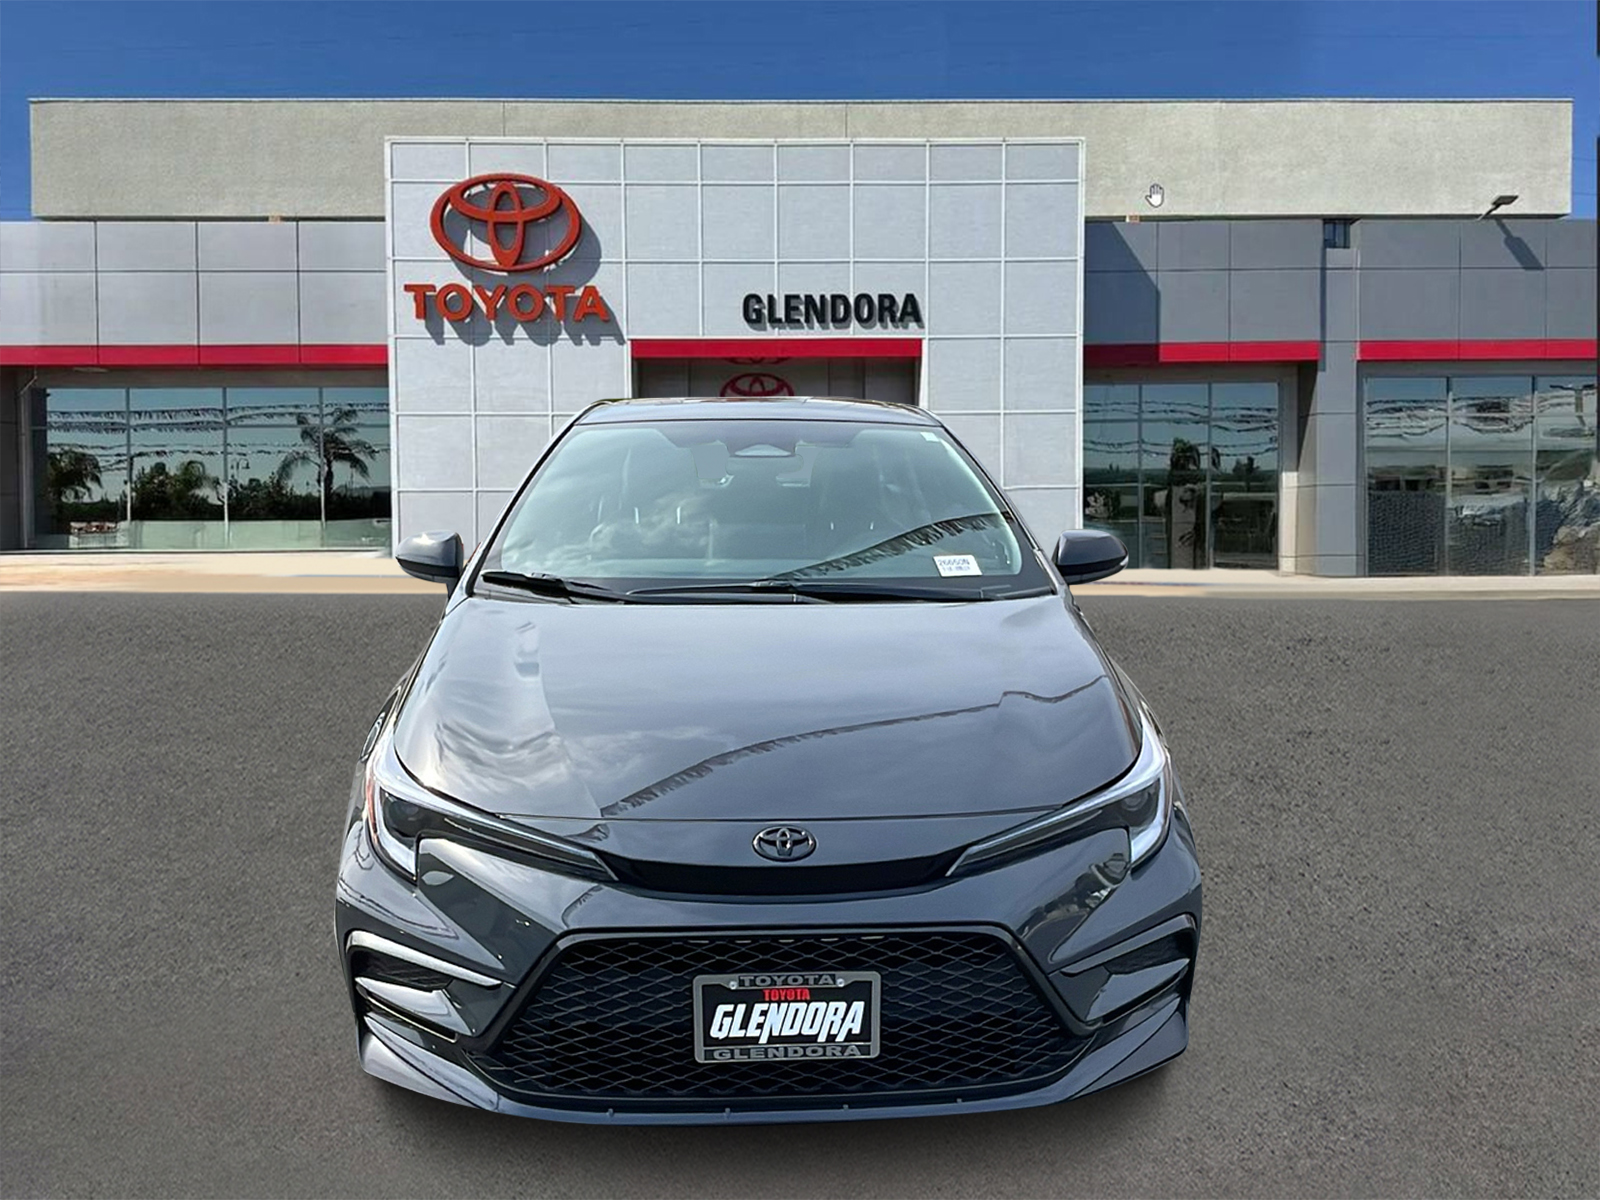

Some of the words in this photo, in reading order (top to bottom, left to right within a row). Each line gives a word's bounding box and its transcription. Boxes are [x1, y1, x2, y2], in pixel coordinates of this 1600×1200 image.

[403, 283, 611, 323] TOYOTA
[742, 293, 923, 326] GLENDORA
[740, 974, 834, 987] TOYOTA
[763, 988, 810, 1001] TOYOTA
[710, 1001, 865, 1044] GLENDORA
[713, 1045, 862, 1060] GLENDORA
